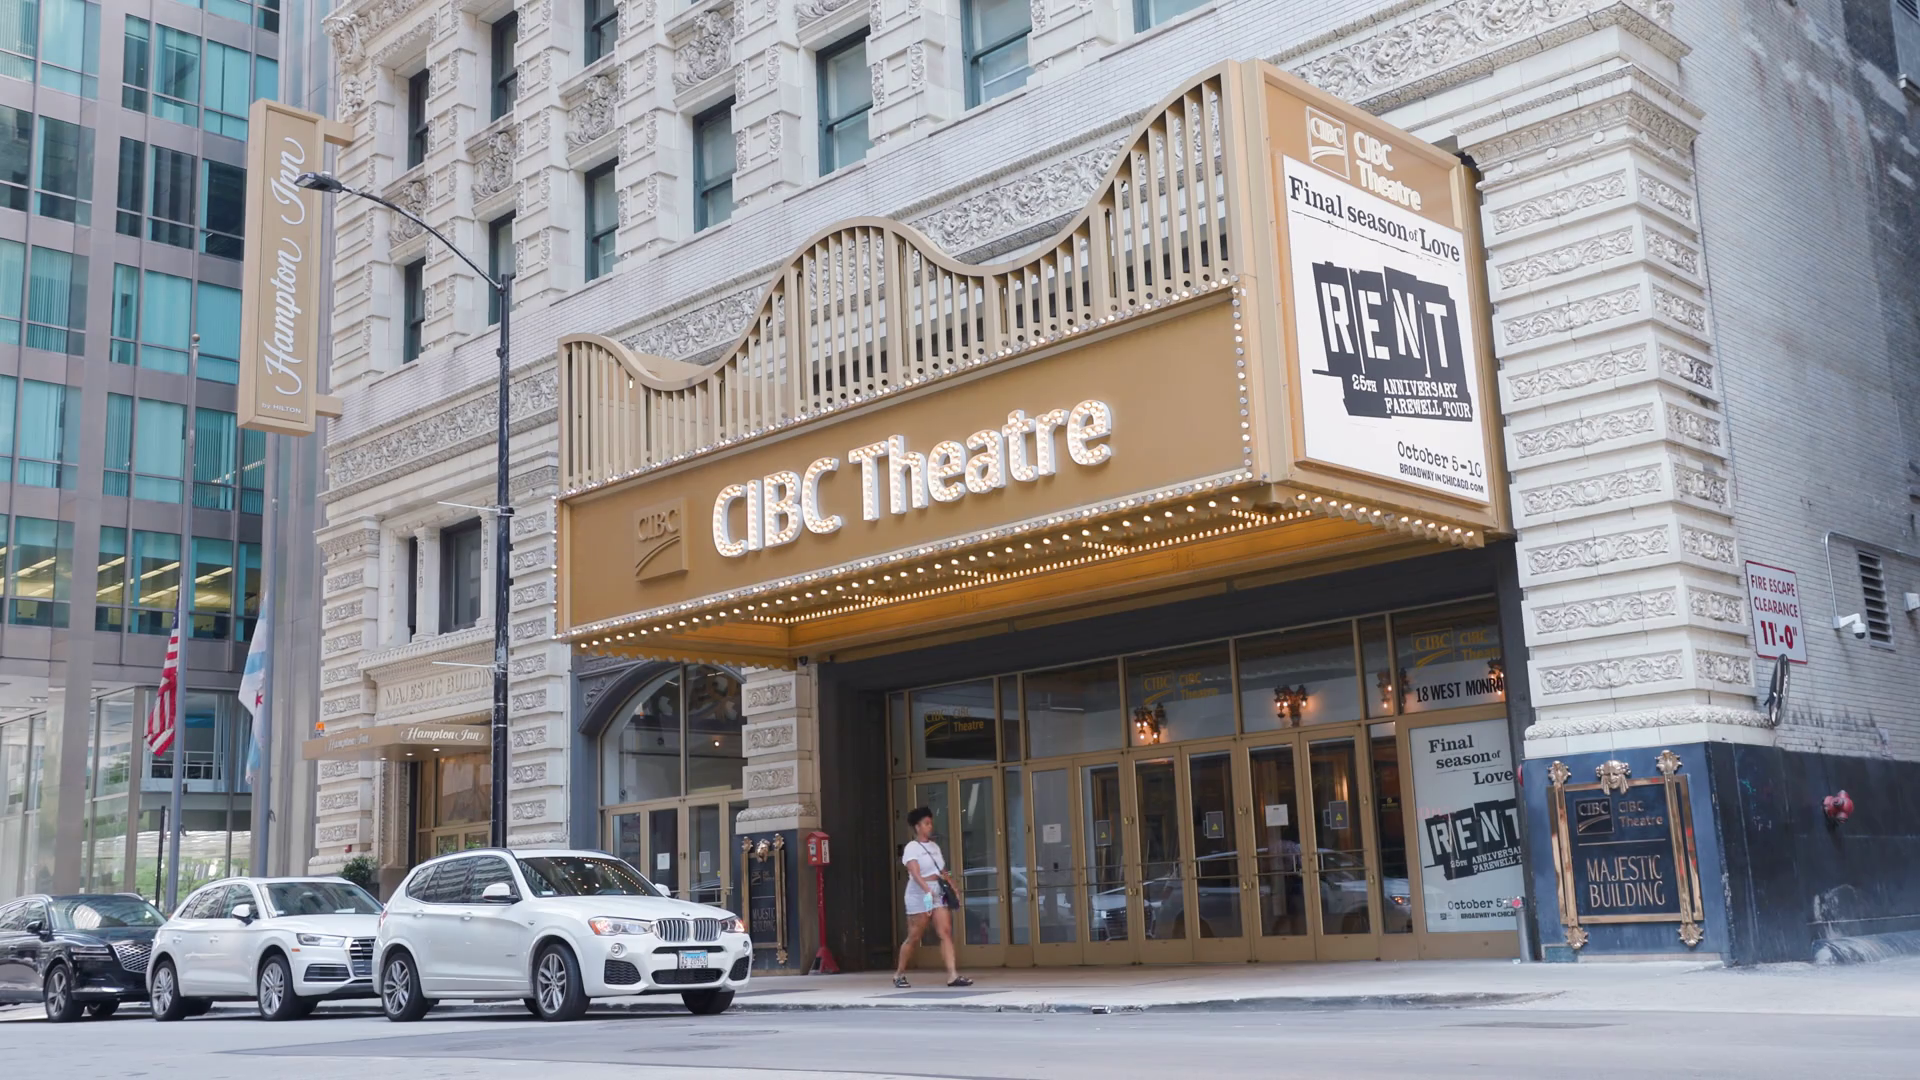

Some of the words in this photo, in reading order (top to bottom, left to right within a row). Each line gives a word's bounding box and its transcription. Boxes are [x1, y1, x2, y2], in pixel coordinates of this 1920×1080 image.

[1310, 117, 1345, 148] CIBC
[1353, 131, 1393, 171] CIBC
[270, 136, 305, 225] Inn
[1356, 159, 1422, 211] Theatre
[1289, 175, 1344, 219] Final
[1347, 204, 1408, 242] season
[1408, 230, 1418, 241] of
[1418, 227, 1460, 262] Love
[263, 237, 302, 395] Hampton
[1320, 281, 1449, 368] RENT
[1383, 378, 1458, 398] ANNIVERSARY
[272, 404, 302, 414] HILTON
[1384, 397, 1442, 416] FAREWELL
[1443, 401, 1472, 418] TOUR
[1397, 440, 1449, 469] October
[1451, 455, 1482, 478] 5-10
[713, 457, 842, 557] CIBC
[848, 399, 1112, 521] Theatre
[1399, 463, 1435, 482] BROADWAY
[638, 509, 680, 541] CIBC
[1750, 574, 1767, 591] FIRE
[1768, 578, 1795, 597] ESCAPE
[1753, 596, 1798, 618] CLEARANCE
[1415, 633, 1450, 652] CIBC
[1460, 630, 1489, 645] CIBC
[1462, 648, 1502, 661] Theatr
[385, 679, 443, 706] MAJESTIC
[446, 668, 493, 694] BUILDIN
[1416, 686, 1429, 702] 18
[1430, 682, 1461, 700] WEST
[1465, 677, 1504, 696] MONRO
[401, 727, 455, 741] Hampton
[455, 729, 485, 741] Inn
[952, 720, 985, 732] Theatre
[1428, 735, 1474, 753] Final
[1436, 751, 1492, 769] season
[1491, 750, 1501, 759] of
[1473, 770, 1514, 785] Love
[1577, 801, 1609, 816] CIBC
[1618, 801, 1645, 813] CIBC
[1430, 807, 1520, 856] RENT
[1618, 815, 1664, 828] Theatre
[1472, 846, 1521, 865] ANNIVERSA
[1472, 857, 1516, 874] FAREWELL
[1586, 854, 1663, 882] MAJESTIC
[1447, 898, 1493, 910] October
[1589, 880, 1666, 908] BUILDING
[1460, 911, 1490, 919] BROADWAY
